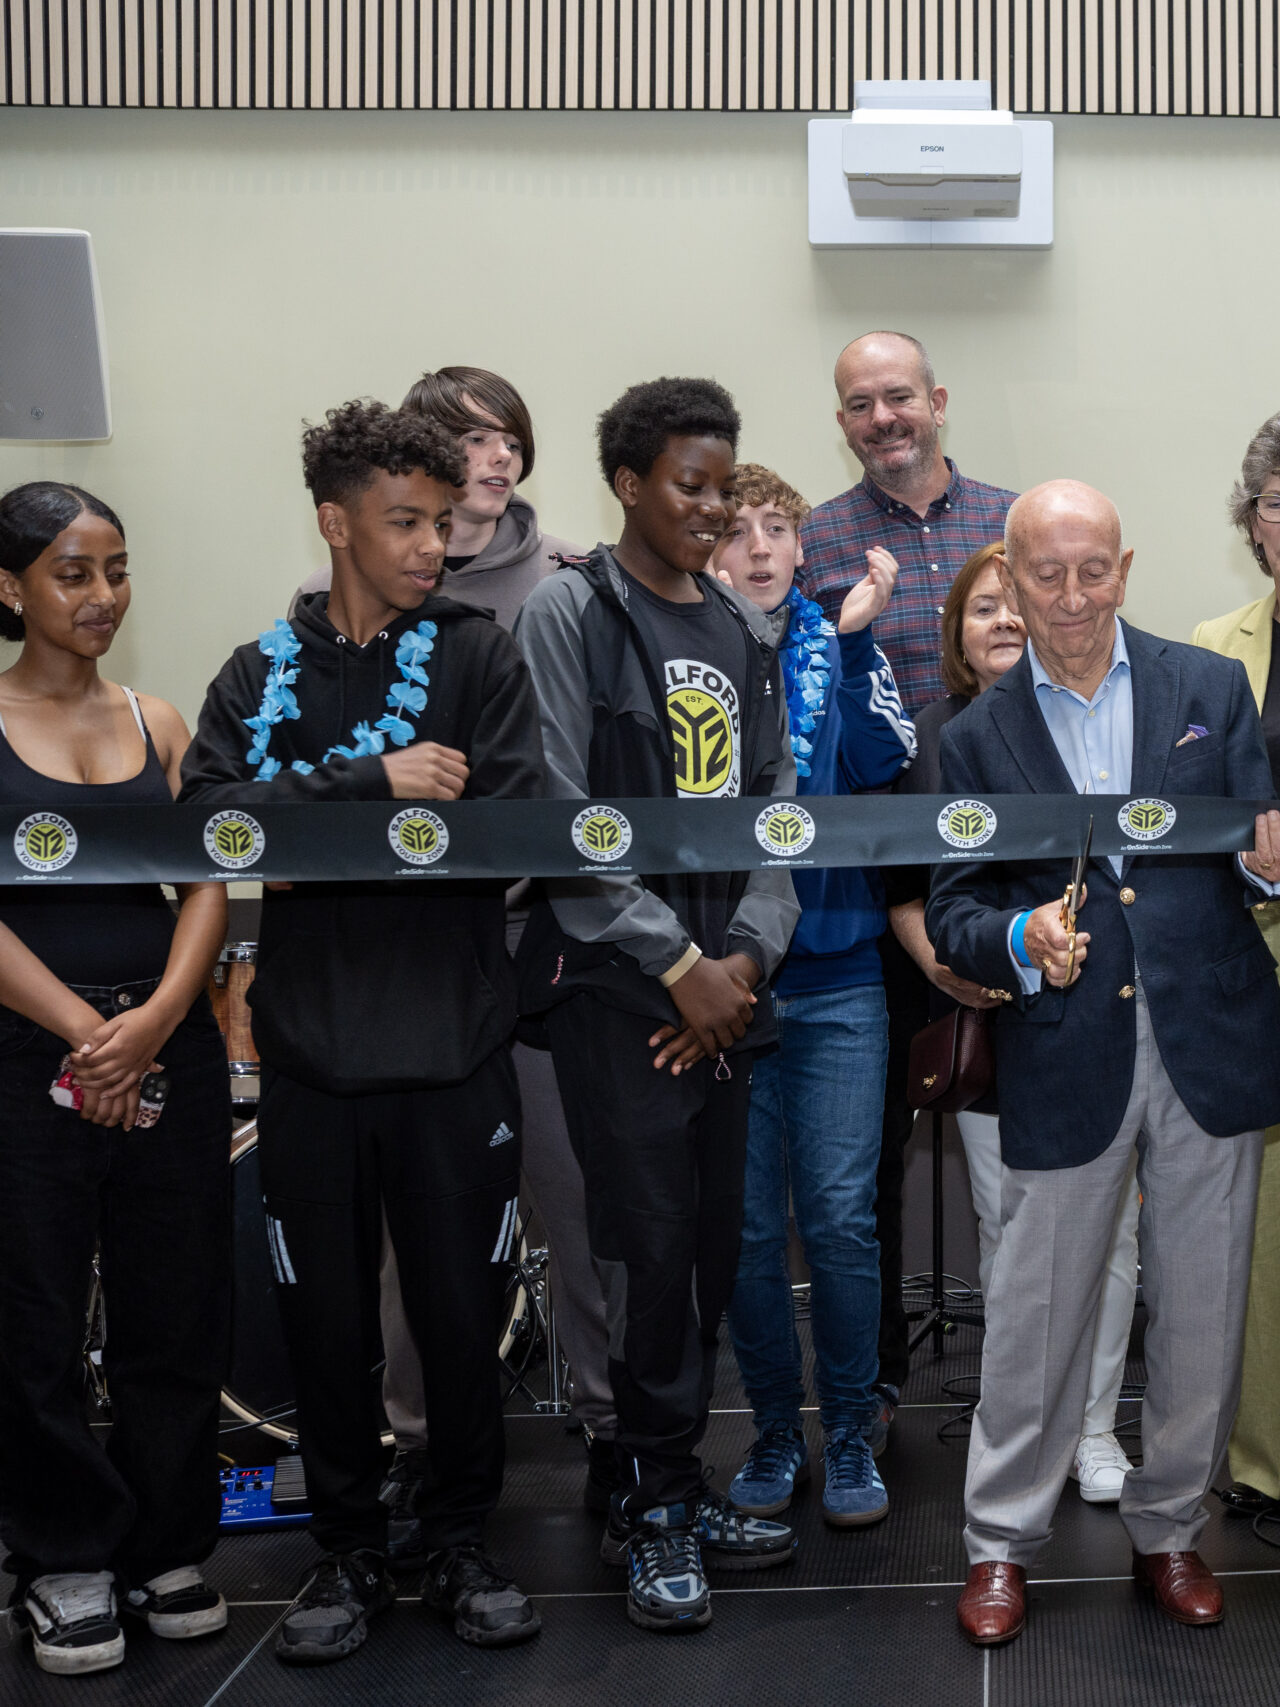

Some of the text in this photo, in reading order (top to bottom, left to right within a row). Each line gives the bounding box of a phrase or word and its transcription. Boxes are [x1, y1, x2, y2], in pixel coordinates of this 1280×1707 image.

[664, 663, 738, 735] LFORD
[758, 804, 811, 826] SALFORD
[941, 801, 993, 821] SALFORD
[1121, 799, 1173, 815] SALFORD
[18, 814, 73, 838] SALFORD
[207, 812, 260, 835] SALFORD
[391, 809, 444, 832] SALFORD
[575, 807, 628, 829] SALFORD
[943, 828, 992, 846] YOUTH ZONE
[1123, 821, 1171, 839] YOUTH ZONE
[395, 843, 445, 862] YOUTH ZONE
[578, 840, 628, 860] YOUTH ZONE
[761, 836, 811, 854] YOUTH ZONE
[20, 850, 73, 869] YOUTH ZONE
[210, 846, 261, 866] YOUTH ZONE
